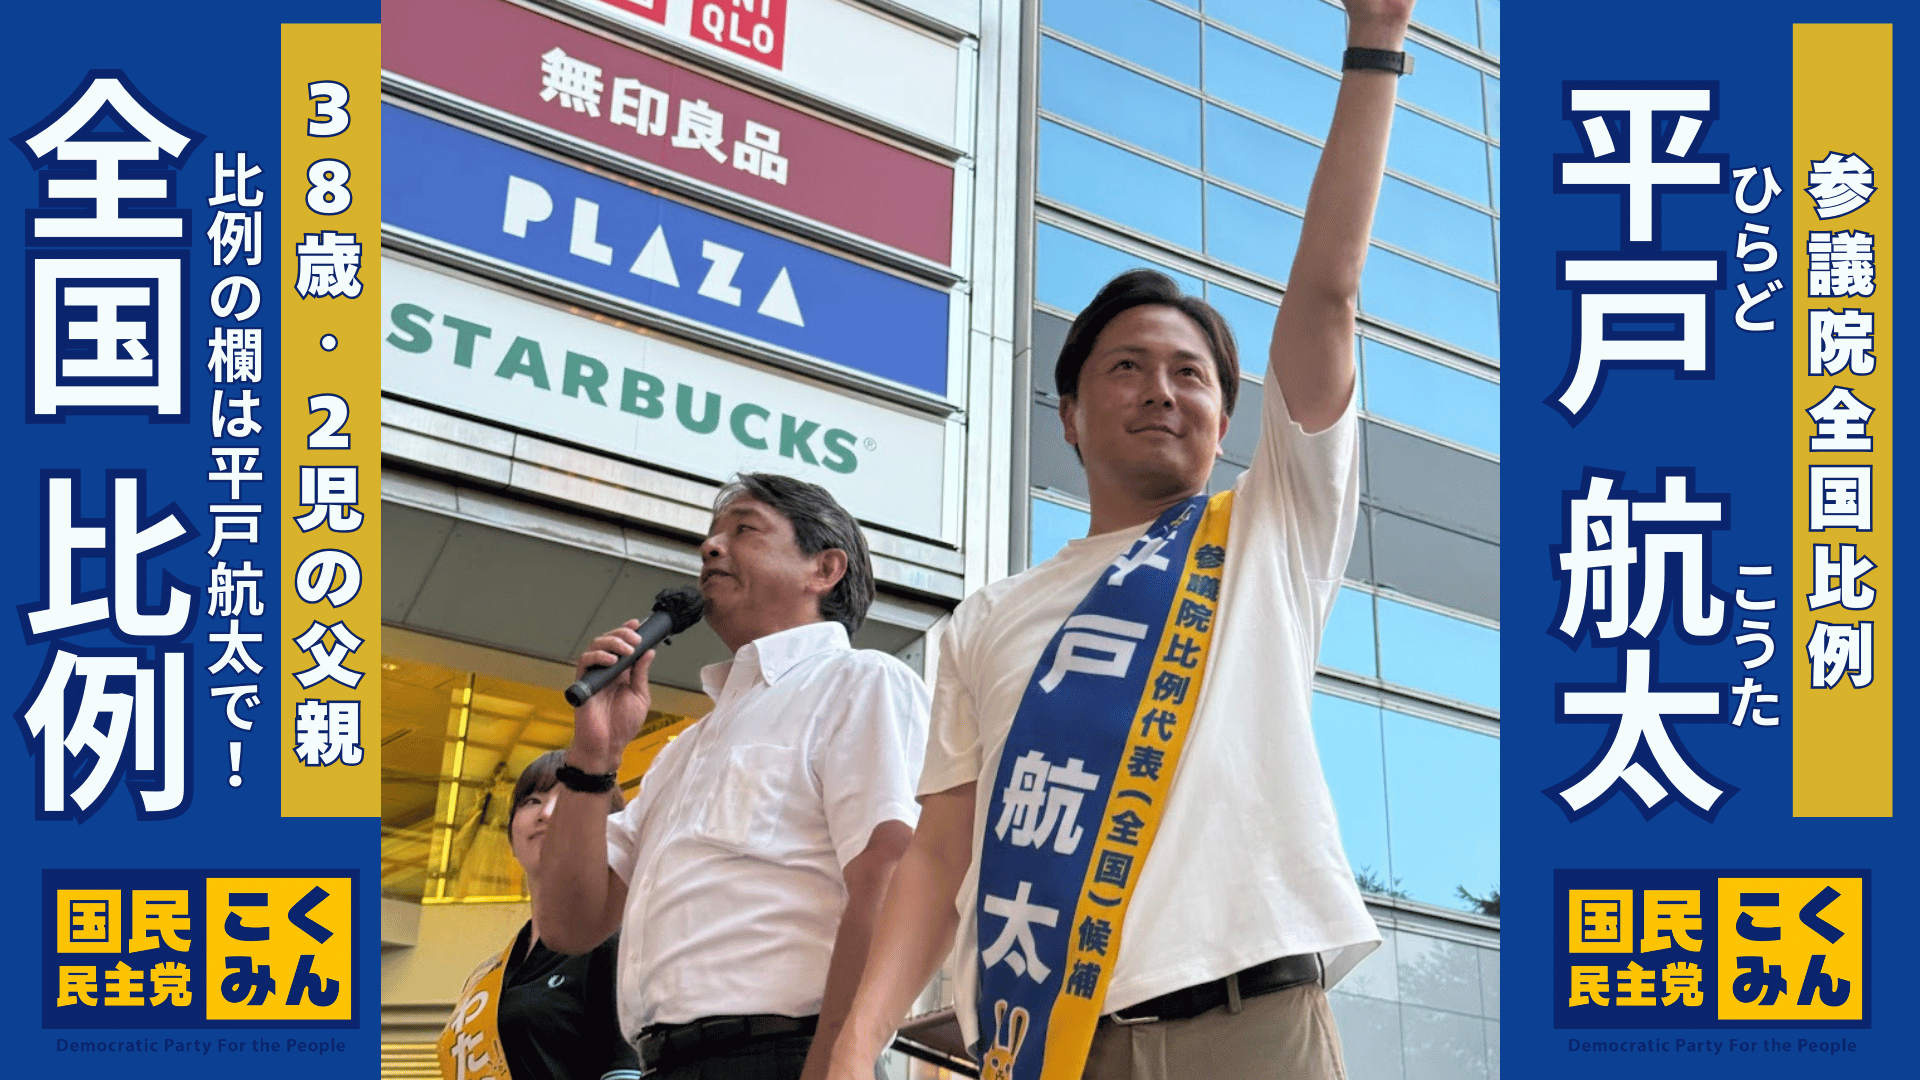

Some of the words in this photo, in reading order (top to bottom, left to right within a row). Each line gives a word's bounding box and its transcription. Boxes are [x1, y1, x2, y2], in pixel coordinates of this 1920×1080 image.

[702, 3, 774, 54] QLO
[539, 46, 789, 186] 無印良品
[503, 175, 805, 328] PLAZA
[386, 302, 859, 475] STARBUCKS
[450, 990, 497, 1080] わた
